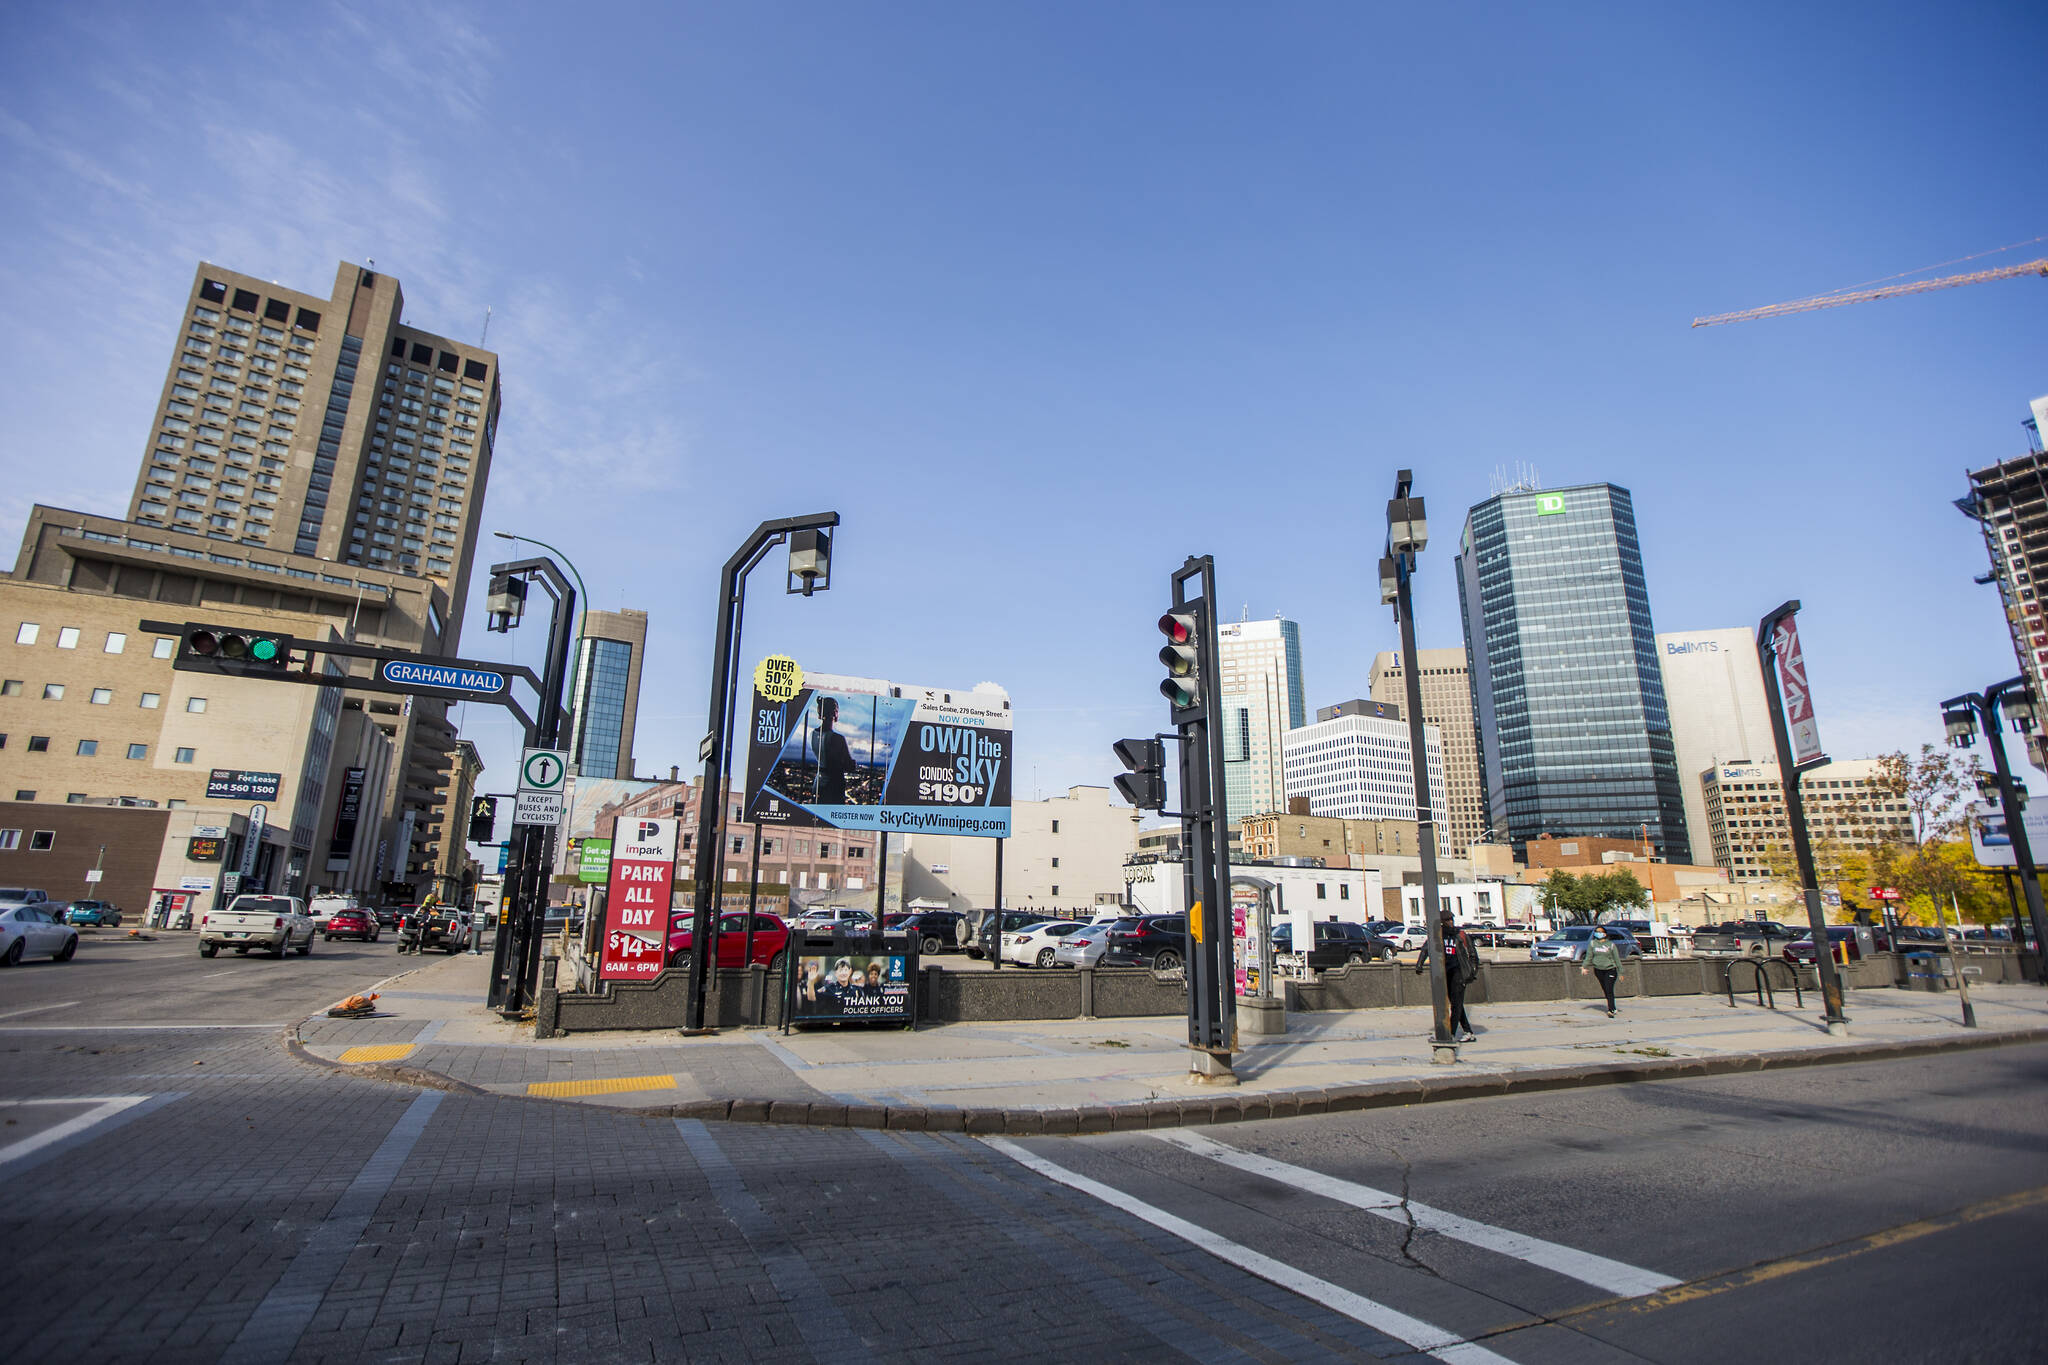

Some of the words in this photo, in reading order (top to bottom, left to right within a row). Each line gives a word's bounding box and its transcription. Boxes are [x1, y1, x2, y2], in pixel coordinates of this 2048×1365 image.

[1539, 496, 1562, 512] TD
[1667, 642, 1718, 654] BellMTS
[766, 658, 794, 672] OVER
[390, 665, 457, 685] GRAHAM
[461, 672, 499, 689] MALL
[766, 671, 793, 686] 50%
[764, 684, 792, 698] SOLD
[759, 710, 780, 726] SKY
[938, 714, 960, 722] NOW
[962, 716, 984, 726] OPEN
[758, 726, 780, 744] CITY
[978, 736, 1002, 758] the
[254, 776, 277, 784] Lease
[920, 766, 954, 782] CONDOS
[1724, 768, 1762, 778] BellMTS
[209, 782, 228, 790] 204
[230, 784, 249, 792] 560
[252, 786, 275, 794] 1500
[528, 796, 552, 804] EXCEPT
[518, 804, 541, 812] BUSES
[522, 812, 554, 822] CYCLISTS
[830, 812, 858, 820] REGISTER
[859, 813, 874, 821] NOW
[880, 810, 1006, 832] SkyCityWinnipeg.com
[586, 846, 599, 854] Get
[626, 844, 662, 856] impark
[620, 864, 664, 882] PARK
[1122, 866, 1155, 883] LOCAL
[624, 888, 654, 903] ALL
[622, 908, 654, 925] DAY
[606, 962, 629, 972] 6AM
[636, 963, 659, 972] 6PM
[844, 996, 880, 1006] THANK
[883, 996, 904, 1005] YOU
